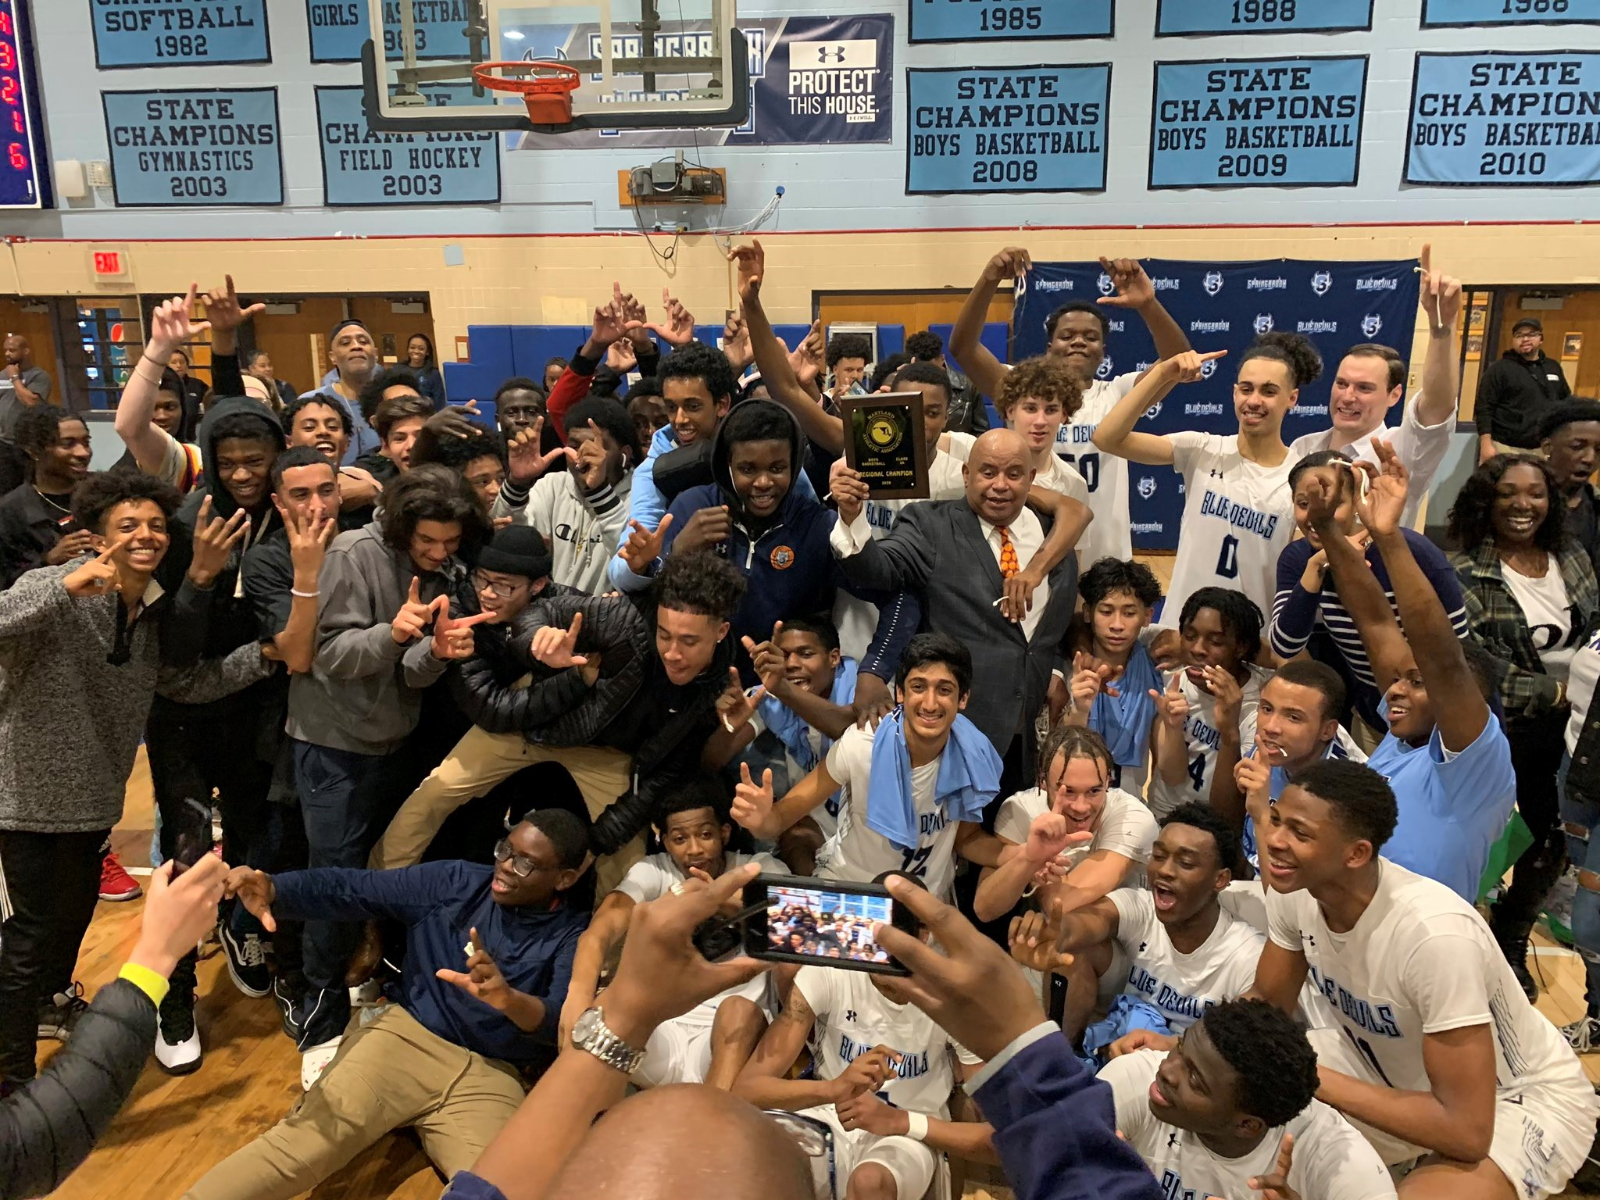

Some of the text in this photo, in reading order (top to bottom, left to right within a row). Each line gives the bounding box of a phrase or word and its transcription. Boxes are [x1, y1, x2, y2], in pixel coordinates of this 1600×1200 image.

[105, 6, 254, 32] SOFTBALL
[312, 4, 359, 26] GIRLS
[980, 7, 1042, 31] 1985
[1231, 0, 1296, 23] 1988
[155, 35, 209, 57] 1982
[788, 68, 875, 95] PROTECT
[1206, 67, 1312, 93] STATE
[1470, 61, 1583, 87] STATE
[957, 75, 1059, 100] STATE
[147, 99, 235, 120] STATE
[788, 95, 880, 115] THIS HOUSE.
[916, 103, 1100, 129] CHAMPIONS
[1160, 94, 1357, 123] CHAMPIONS
[1419, 91, 1600, 117] CHAMPION
[113, 124, 274, 147] CHAMPIONS
[914, 131, 1100, 157] BOYS BASKETBALL
[1158, 124, 1353, 151] BOYS BASKETBALL
[1414, 122, 1600, 147] BOYS BASKETBA
[138, 150, 254, 173] GYMNASTICS
[340, 147, 482, 171] FIELD HOCKEY
[1218, 153, 1288, 177] 2009
[1479, 152, 1546, 175] 2010
[973, 160, 1038, 183] 2008
[170, 176, 228, 198] 2003
[382, 174, 442, 196] 2003
[1247, 278, 1287, 291] SPRINGBROOK
[1130, 521, 1163, 534] PRINGBROOK
[1230, 503, 1279, 540] DEVILS
[1215, 533, 1239, 579] 0
[1188, 752, 1206, 792] 4
[1128, 964, 1158, 996] LUE
